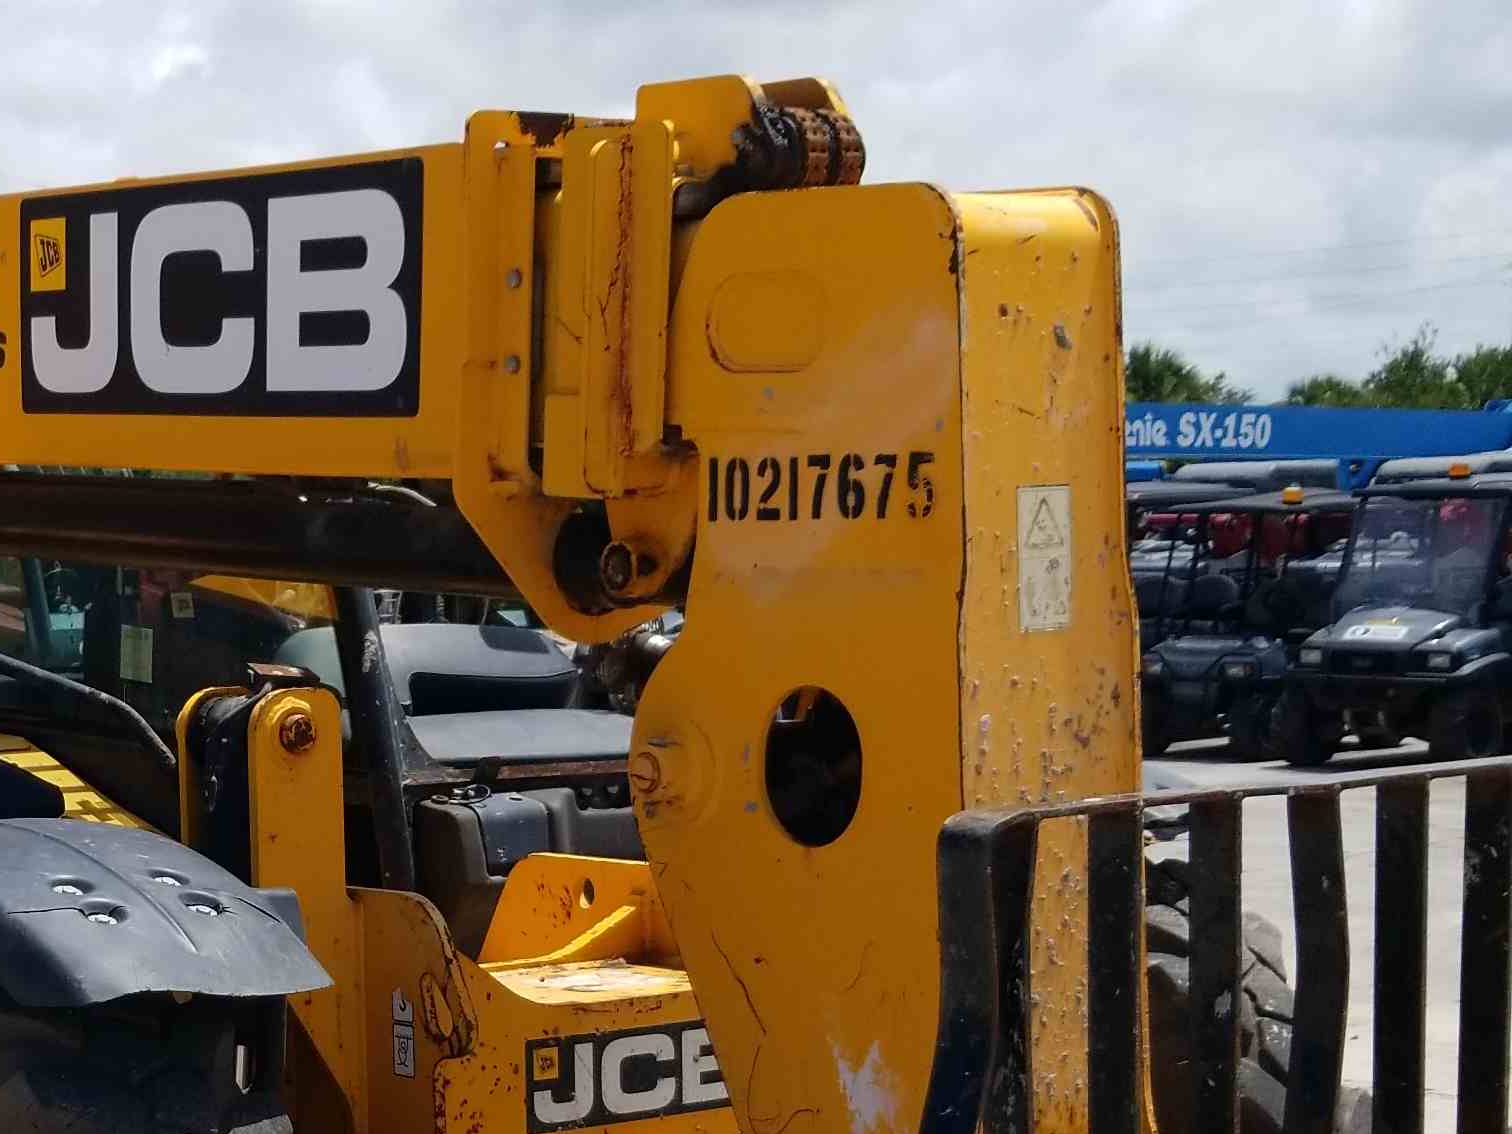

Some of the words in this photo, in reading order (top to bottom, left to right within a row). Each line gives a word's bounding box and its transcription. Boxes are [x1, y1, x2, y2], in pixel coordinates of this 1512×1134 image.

[39, 237, 61, 273] JCB
[31, 188, 408, 394] JCB
[1125, 412, 1168, 447] enie
[1176, 411, 1273, 449] SX-150
[707, 451, 936, 522] 10217675
